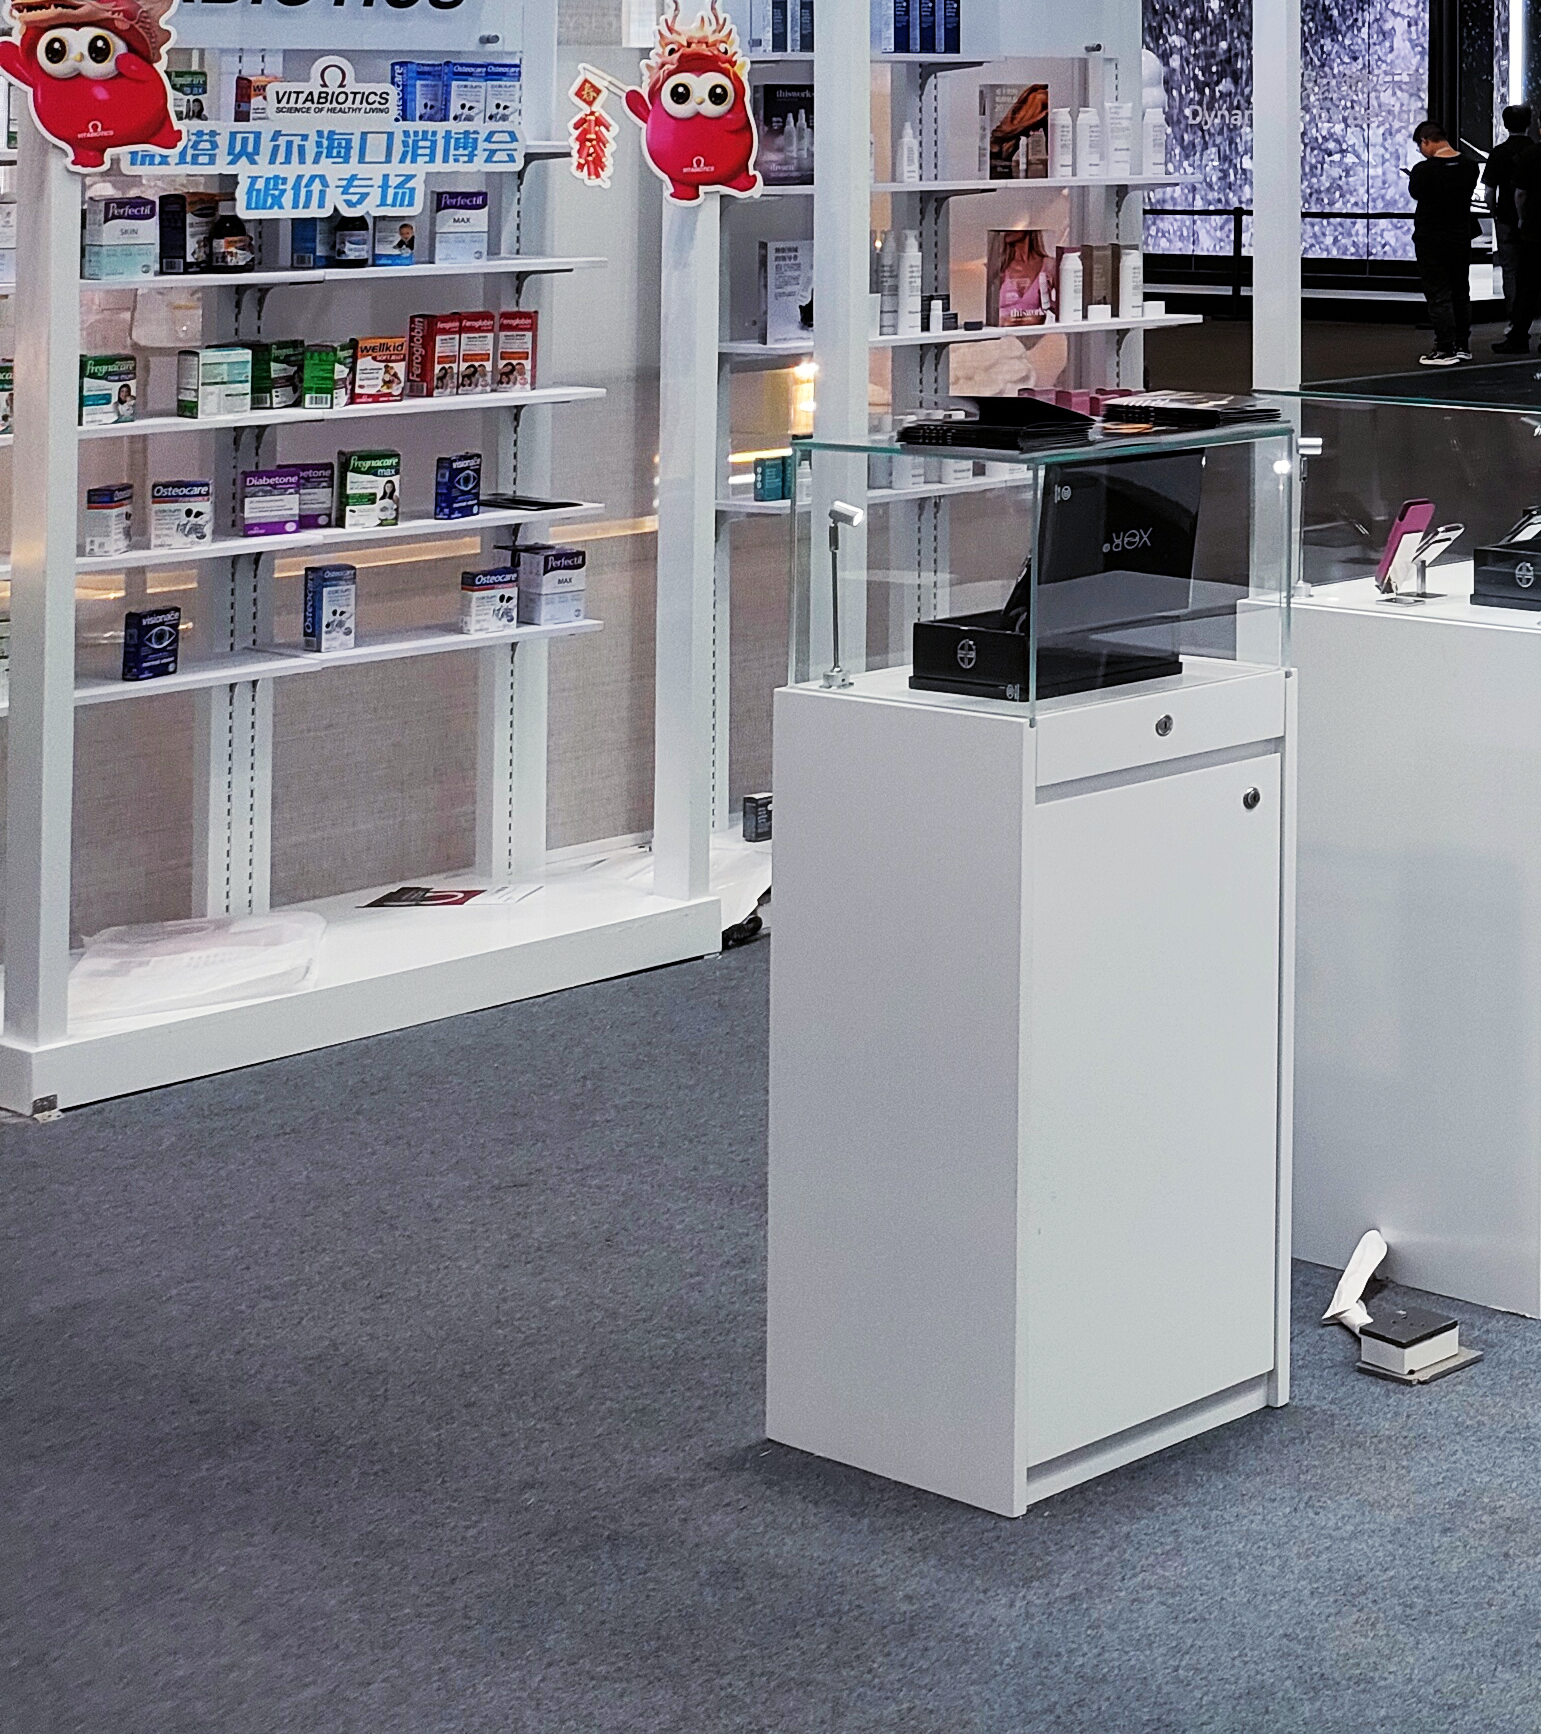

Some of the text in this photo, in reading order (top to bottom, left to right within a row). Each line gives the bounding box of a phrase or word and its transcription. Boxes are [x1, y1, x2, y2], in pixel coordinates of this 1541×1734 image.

[275, 90, 390, 106] VITABIOTICS
[275, 106, 312, 114] SCIENCE
[363, 107, 390, 115] LIVING
[245, 173, 418, 211] 破价专场
[440, 192, 484, 207] Perfectil
[109, 203, 152, 217] Perfectil
[360, 342, 405, 354] wellkid
[409, 317, 425, 382] Feroglobin
[349, 455, 399, 472] Pregnacare
[377, 468, 396, 476] max
[246, 475, 299, 486] Diabetone
[154, 485, 209, 497] Osteocare
[547, 555, 584, 570] Perfectil
[475, 572, 518, 586] Osteocare
[557, 577, 573, 585] MAX
